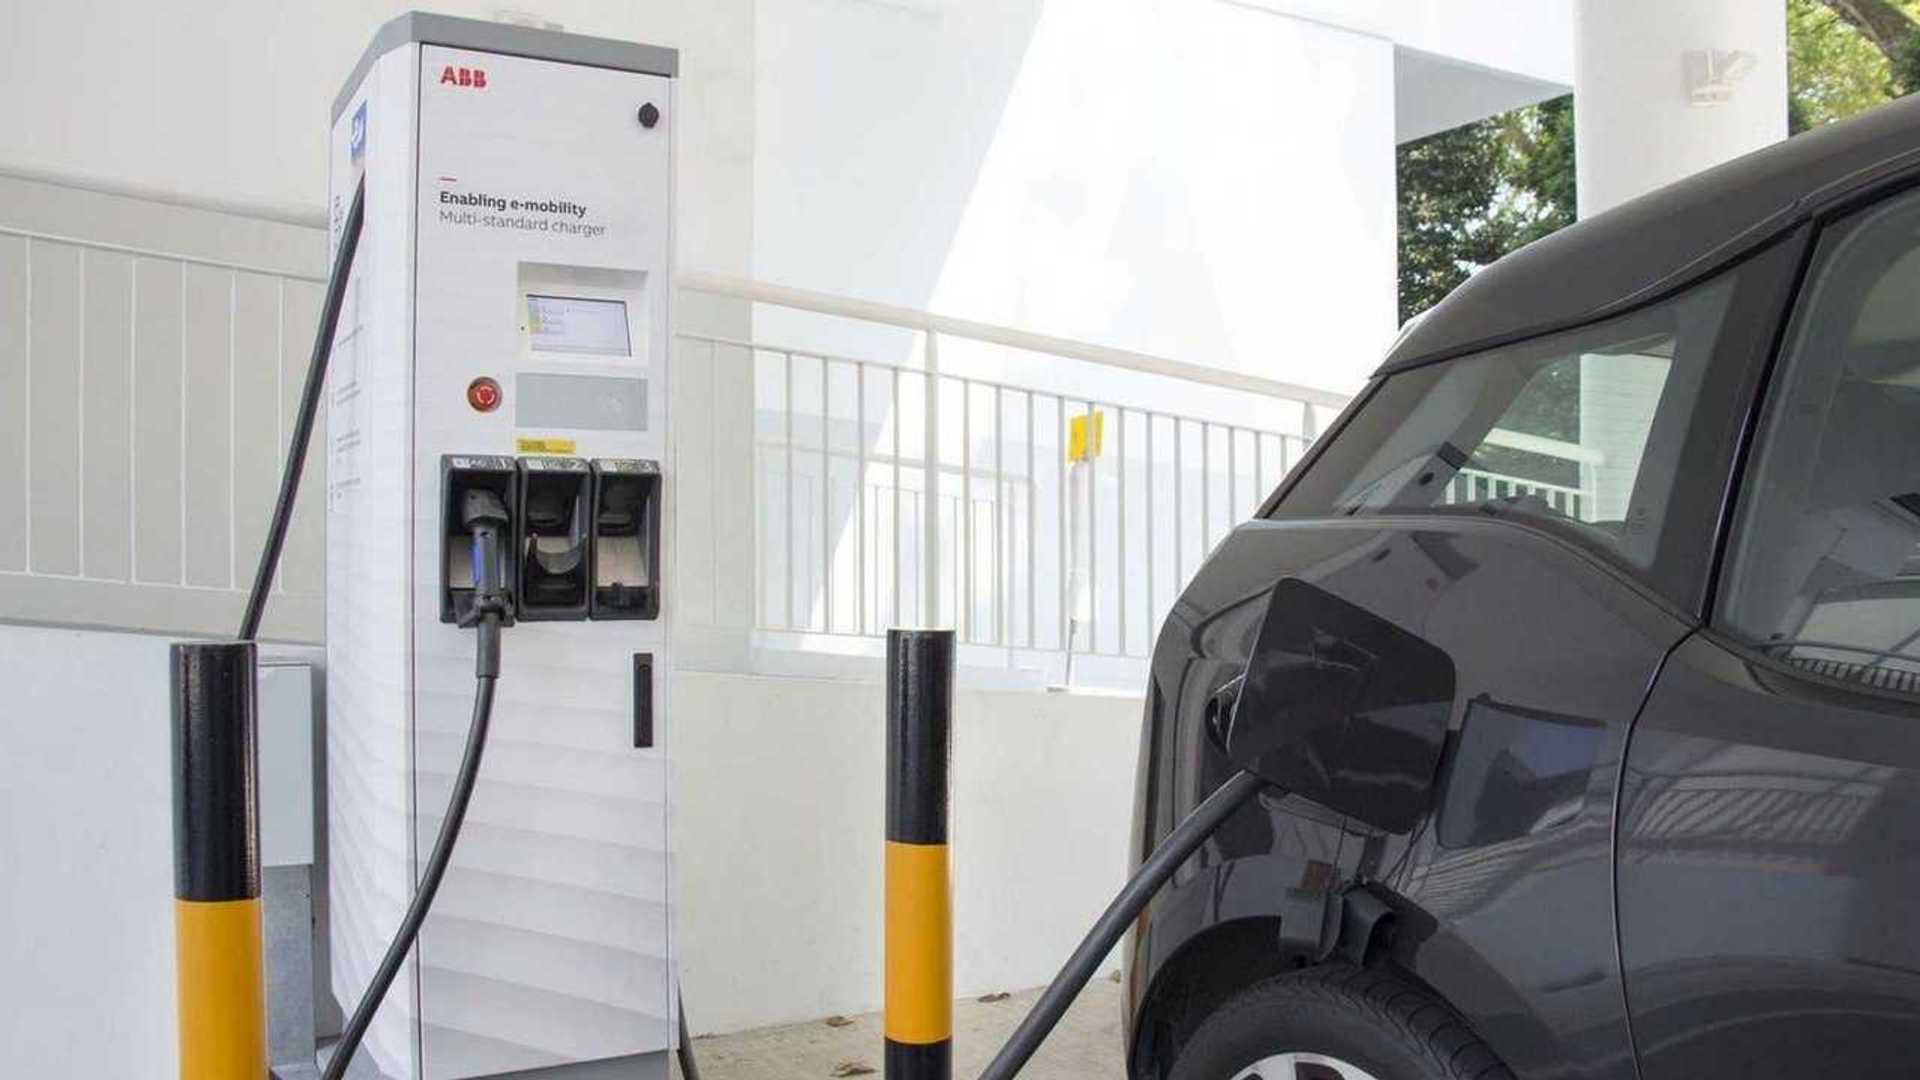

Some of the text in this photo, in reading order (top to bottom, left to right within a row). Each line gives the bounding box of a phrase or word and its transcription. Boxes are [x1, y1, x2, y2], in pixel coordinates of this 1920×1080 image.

[440, 66, 487, 88] ABB
[439, 190, 587, 219] Enabling e-mobility
[439, 210, 607, 238] Multi-standard charger
